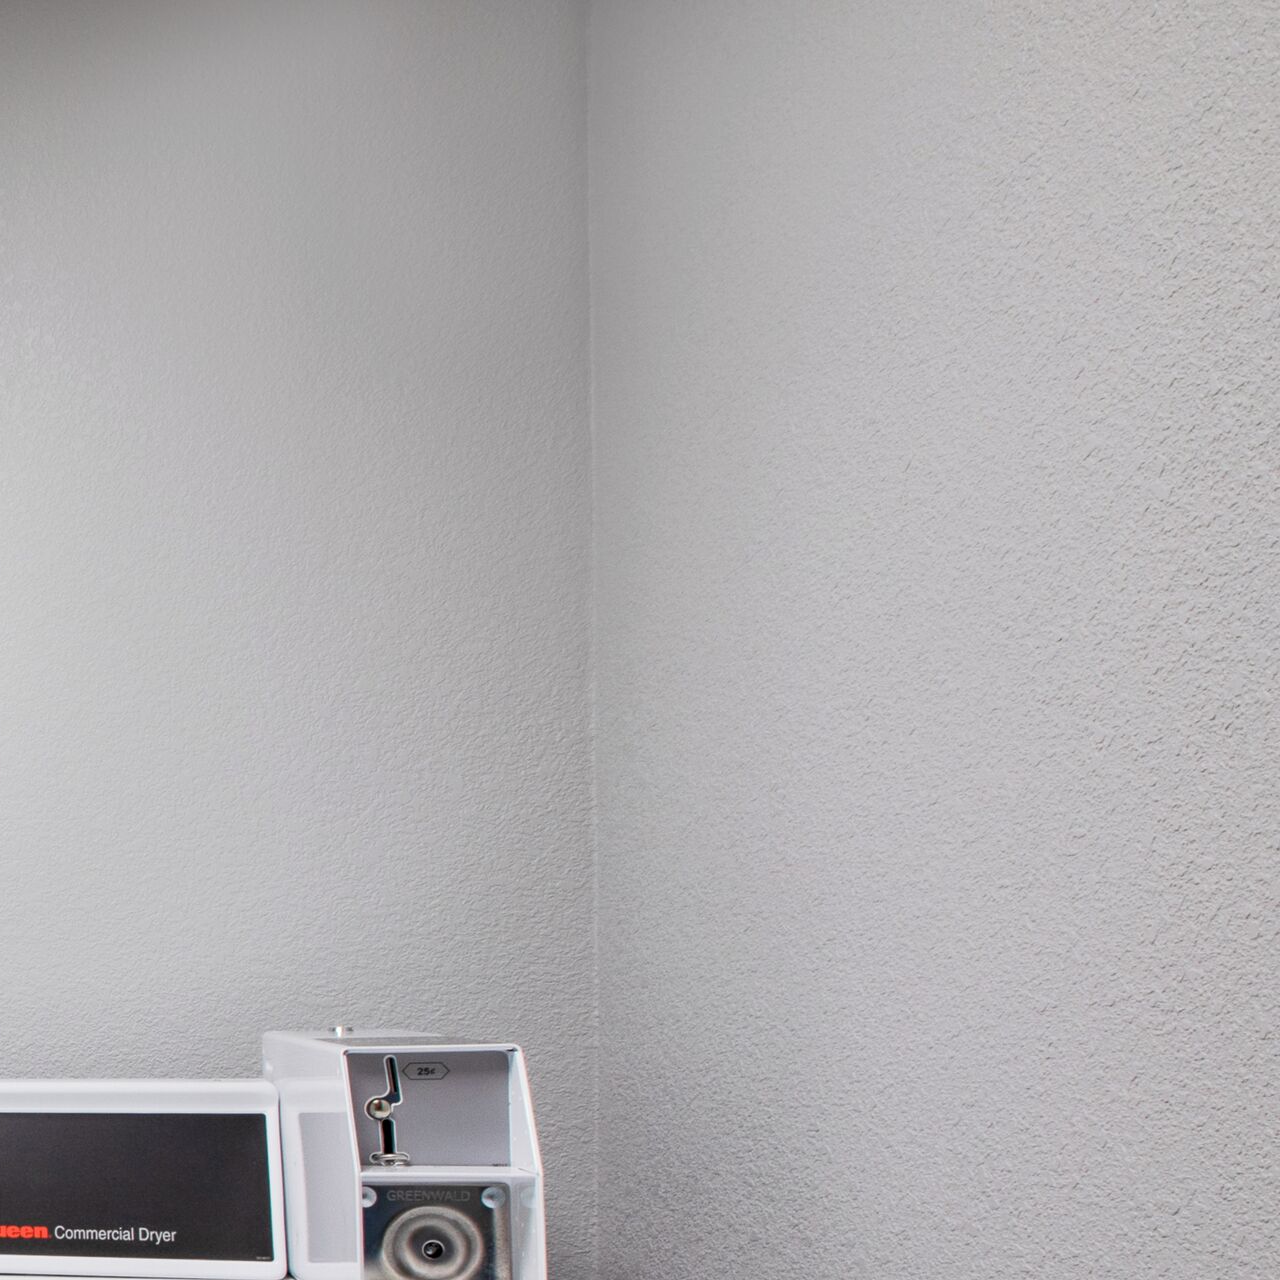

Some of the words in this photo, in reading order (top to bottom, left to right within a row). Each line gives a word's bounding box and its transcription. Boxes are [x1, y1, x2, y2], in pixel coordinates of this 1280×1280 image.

[386, 1190, 471, 1202] GREENWALD
[54, 1225, 135, 1242] Commercial
[139, 1227, 177, 1245] Dryer
